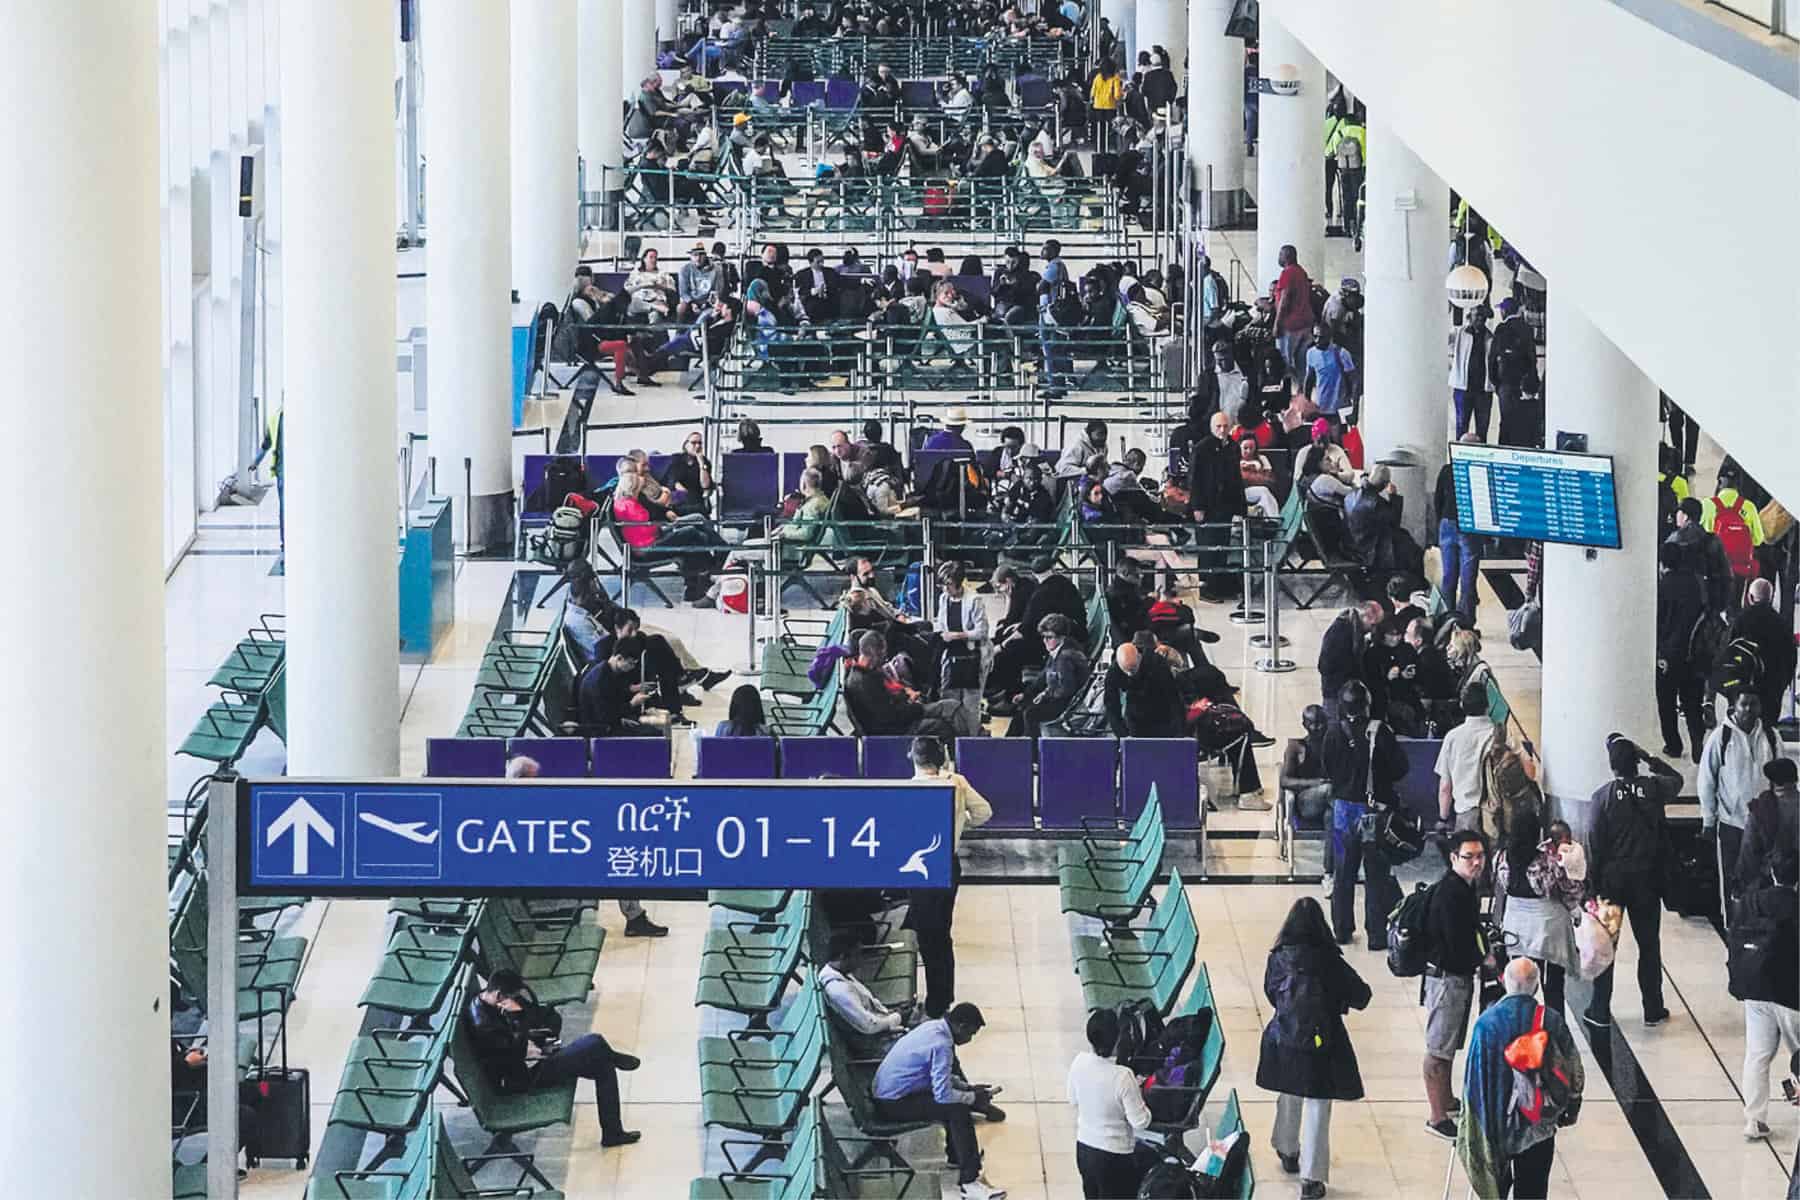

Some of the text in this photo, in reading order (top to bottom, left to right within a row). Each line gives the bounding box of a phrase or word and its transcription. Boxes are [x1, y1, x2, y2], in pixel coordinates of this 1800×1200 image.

[1511, 452, 1564, 465] Departures
[617, 796, 691, 832] በሮች
[456, 819, 592, 854] GATES
[607, 846, 702, 877] 登机口
